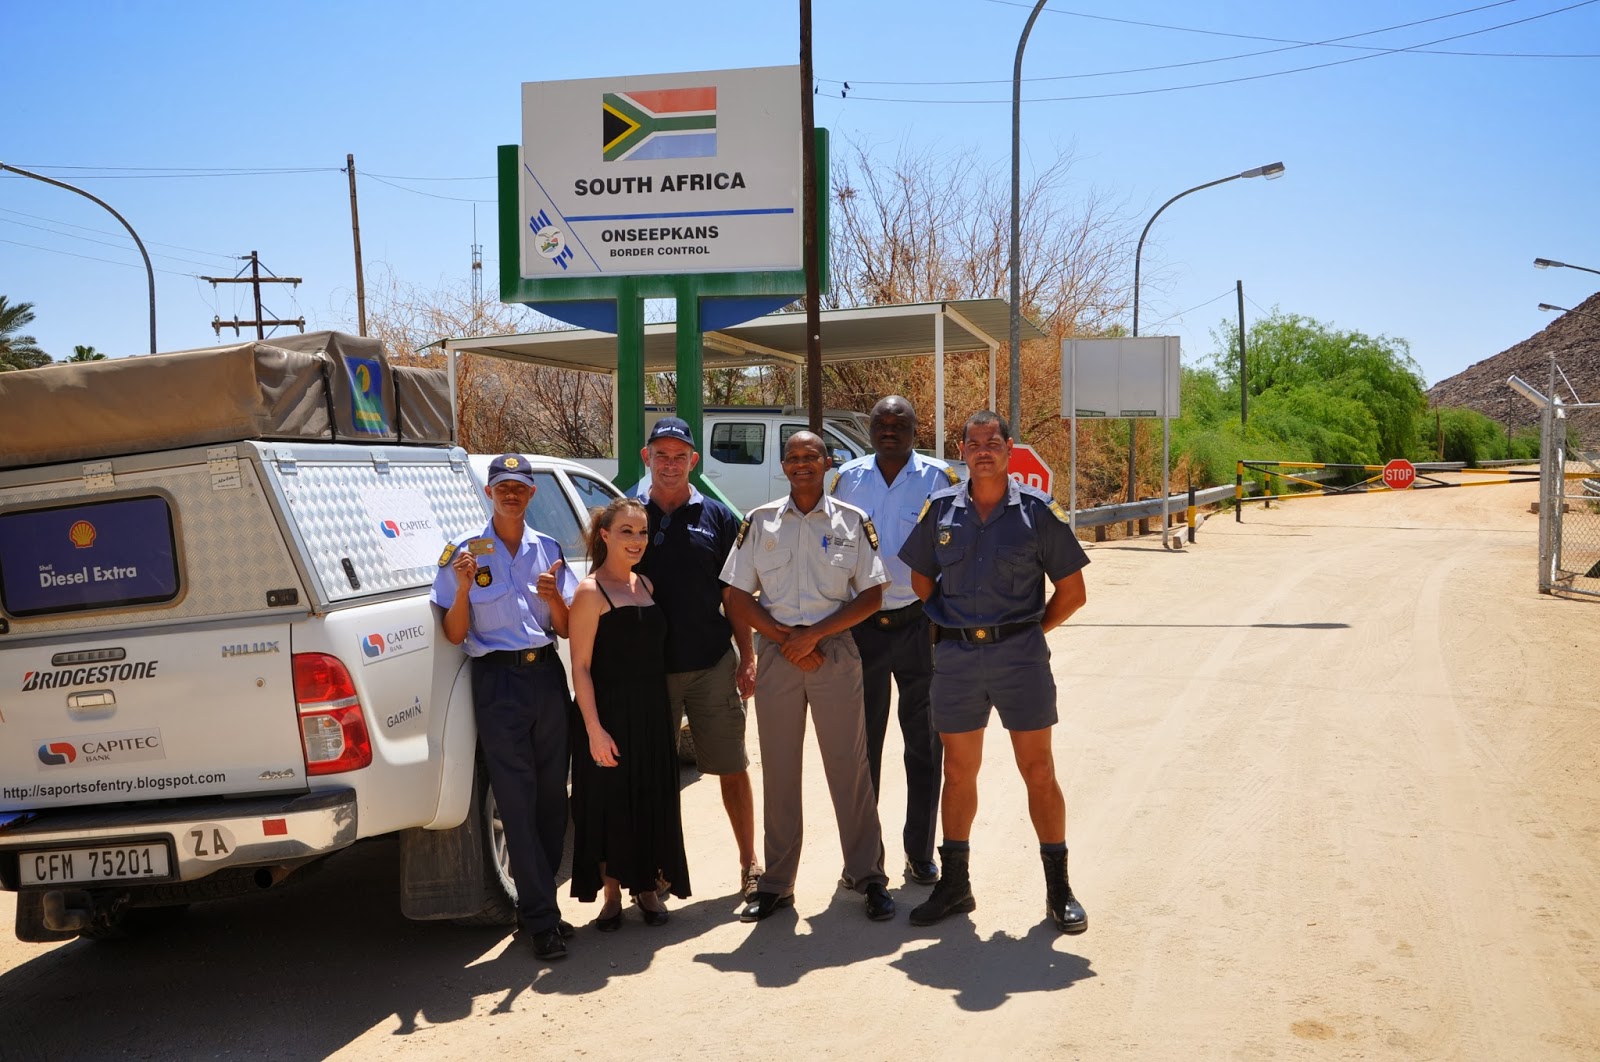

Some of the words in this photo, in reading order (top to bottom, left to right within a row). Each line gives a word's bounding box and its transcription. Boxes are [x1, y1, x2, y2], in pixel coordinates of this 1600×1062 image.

[574, 176, 653, 196] SOUTH
[660, 172, 746, 193] AFRICA
[601, 225, 719, 243] ONSEEPKANS
[610, 247, 655, 258] BORDER
[657, 245, 710, 256] CONTROL
[1385, 468, 1413, 481] STOP
[400, 519, 432, 531] CAPITEC
[39, 564, 53, 572] Shell
[40, 567, 89, 588] Diesel
[93, 566, 138, 582] Extra
[386, 625, 425, 644] CAPITEC
[222, 640, 280, 658] HILUX
[389, 644, 403, 653] BANK
[22, 660, 159, 692] BRIDGESTONE
[387, 704, 422, 728] GARMIN
[82, 736, 159, 754] CAPITEC
[85, 754, 111, 763] BANK
[258, 768, 295, 780] 4x4
[3, 772, 226, 800] http://saportsofentry.blogspot.com
[35, 853, 74, 881] CFM
[88, 848, 154, 878] 75201
